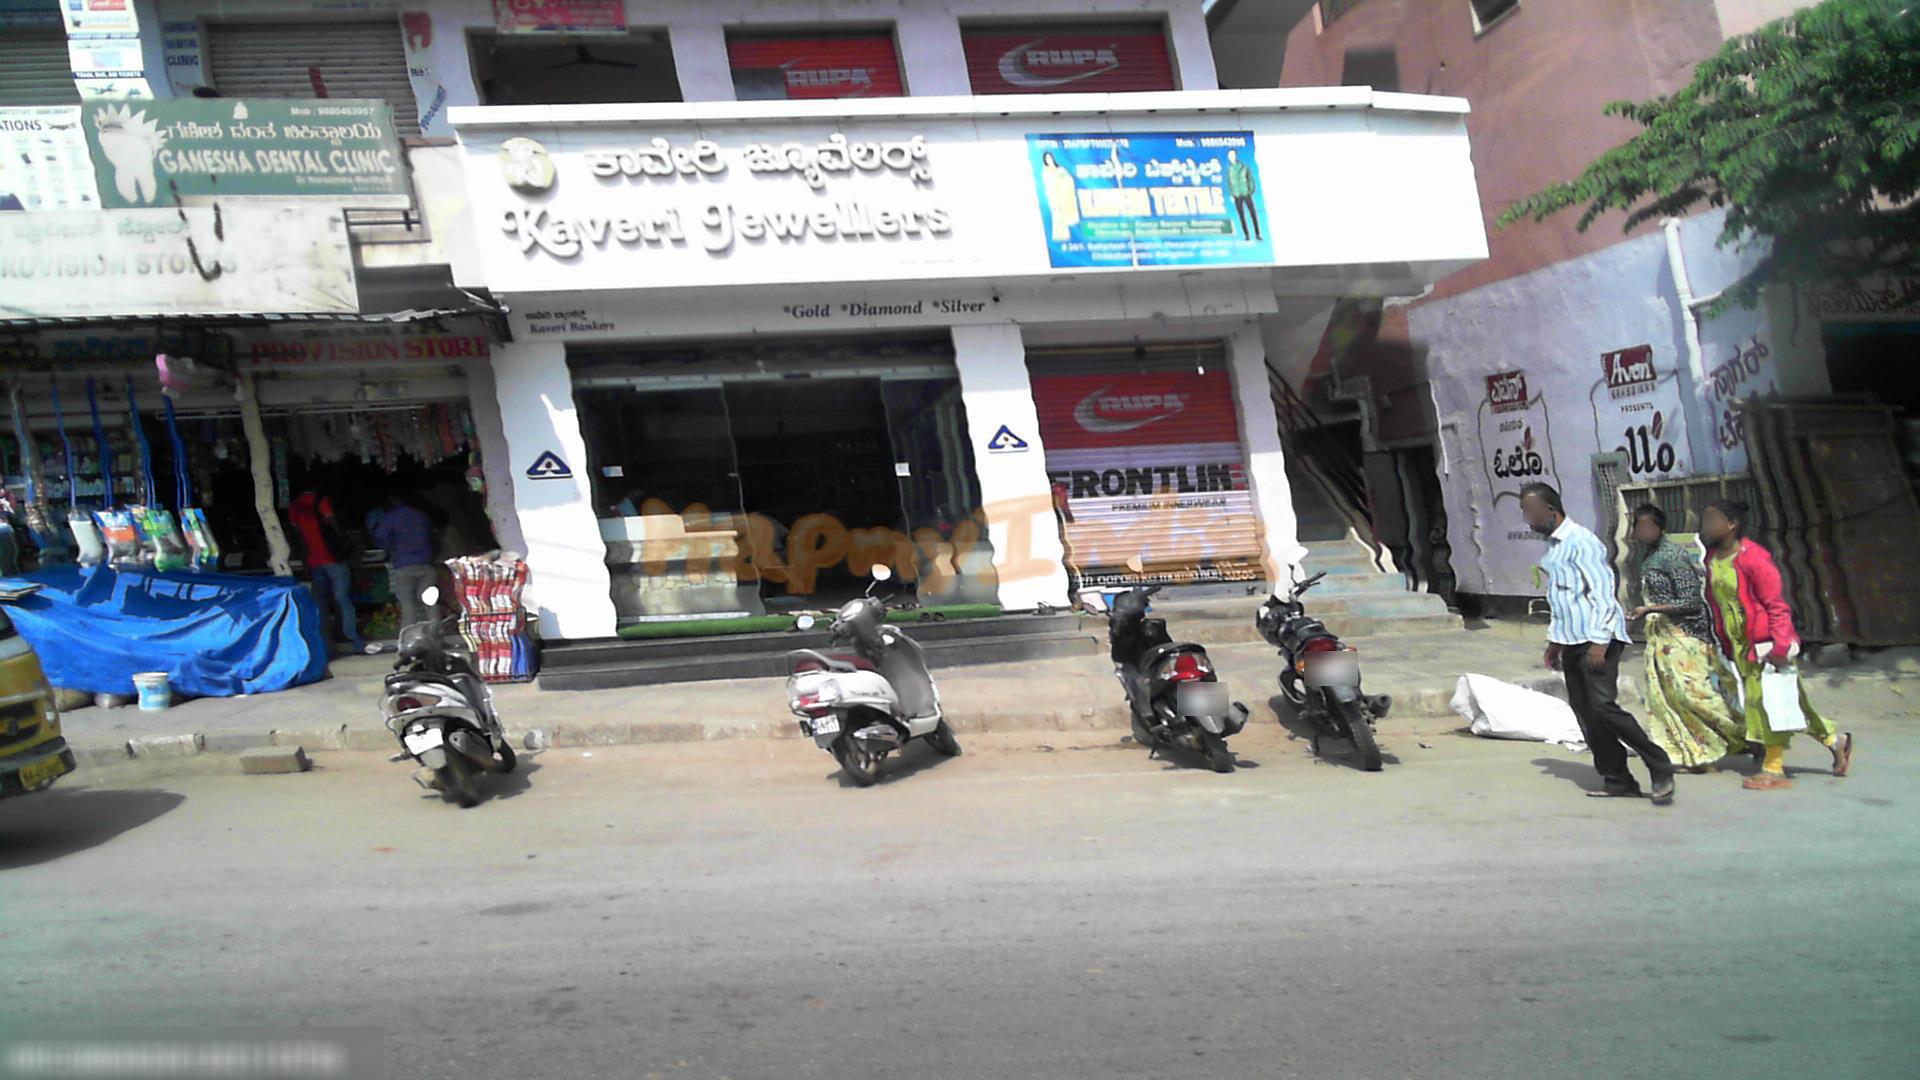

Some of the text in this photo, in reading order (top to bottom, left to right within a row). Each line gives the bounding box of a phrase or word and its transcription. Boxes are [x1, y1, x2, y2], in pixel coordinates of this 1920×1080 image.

[167, 55, 199, 66] CLINIC
[1025, 49, 1118, 65] RUPA
[786, 68, 870, 87] RUPA
[0, 120, 42, 132] TIONS
[158, 149, 396, 175] GANESHA DENTAL CLINIC
[501, 200, 953, 259] Kaveri Jewellers
[529, 321, 616, 334] Kaveri Bankers
[250, 340, 398, 365] PROVISION
[1610, 353, 1654, 386] Avon
[1100, 393, 1184, 411] RUPA
[1615, 425, 1675, 475] llo
[1110, 497, 1228, 512] PREMIUM INNERWEAR
